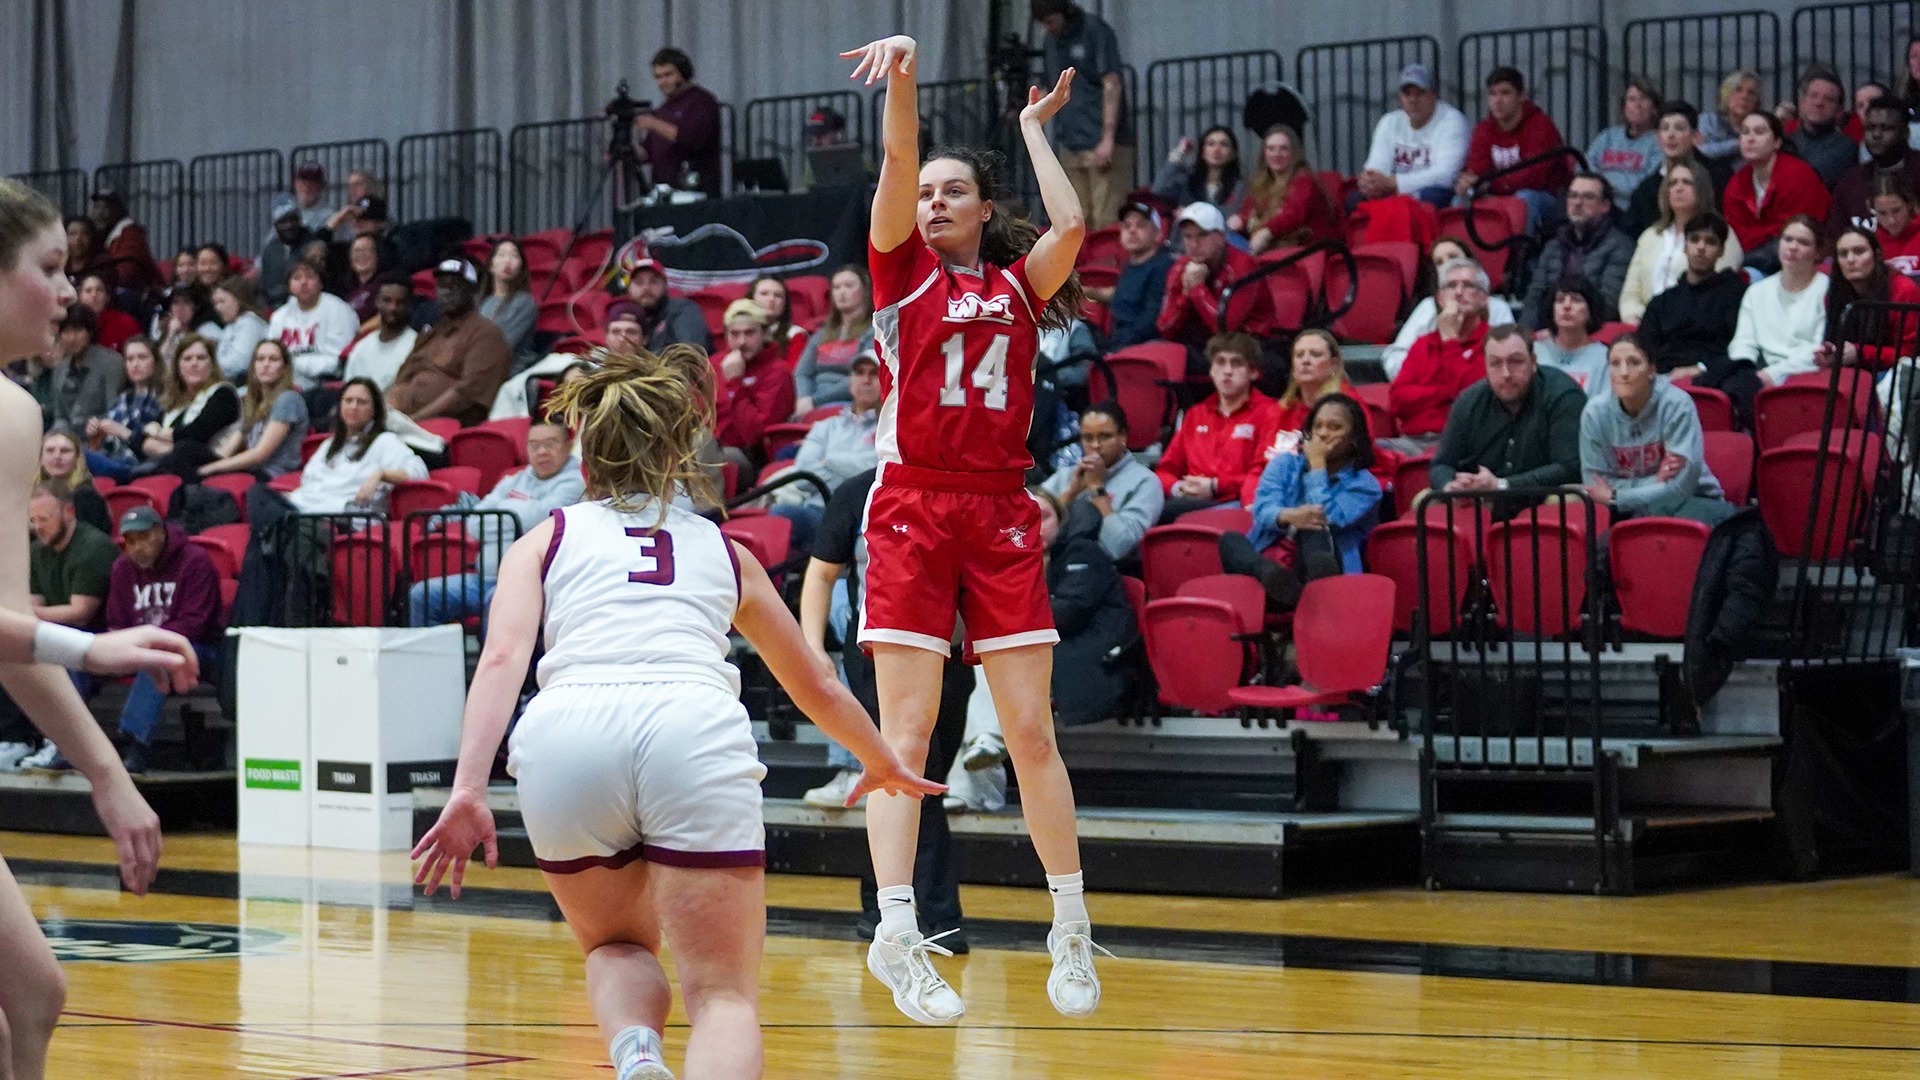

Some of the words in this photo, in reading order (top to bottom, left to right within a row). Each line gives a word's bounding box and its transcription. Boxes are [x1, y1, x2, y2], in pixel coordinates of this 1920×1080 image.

[945, 292, 1015, 322] WPI
[939, 331, 1011, 412] 14
[624, 526, 675, 586] 3
[132, 581, 177, 611] MIT
[247, 767, 272, 781] FOOD
[272, 769, 300, 783] WASTE
[332, 771, 356, 784] TRASH
[409, 771, 441, 783] TRASH
